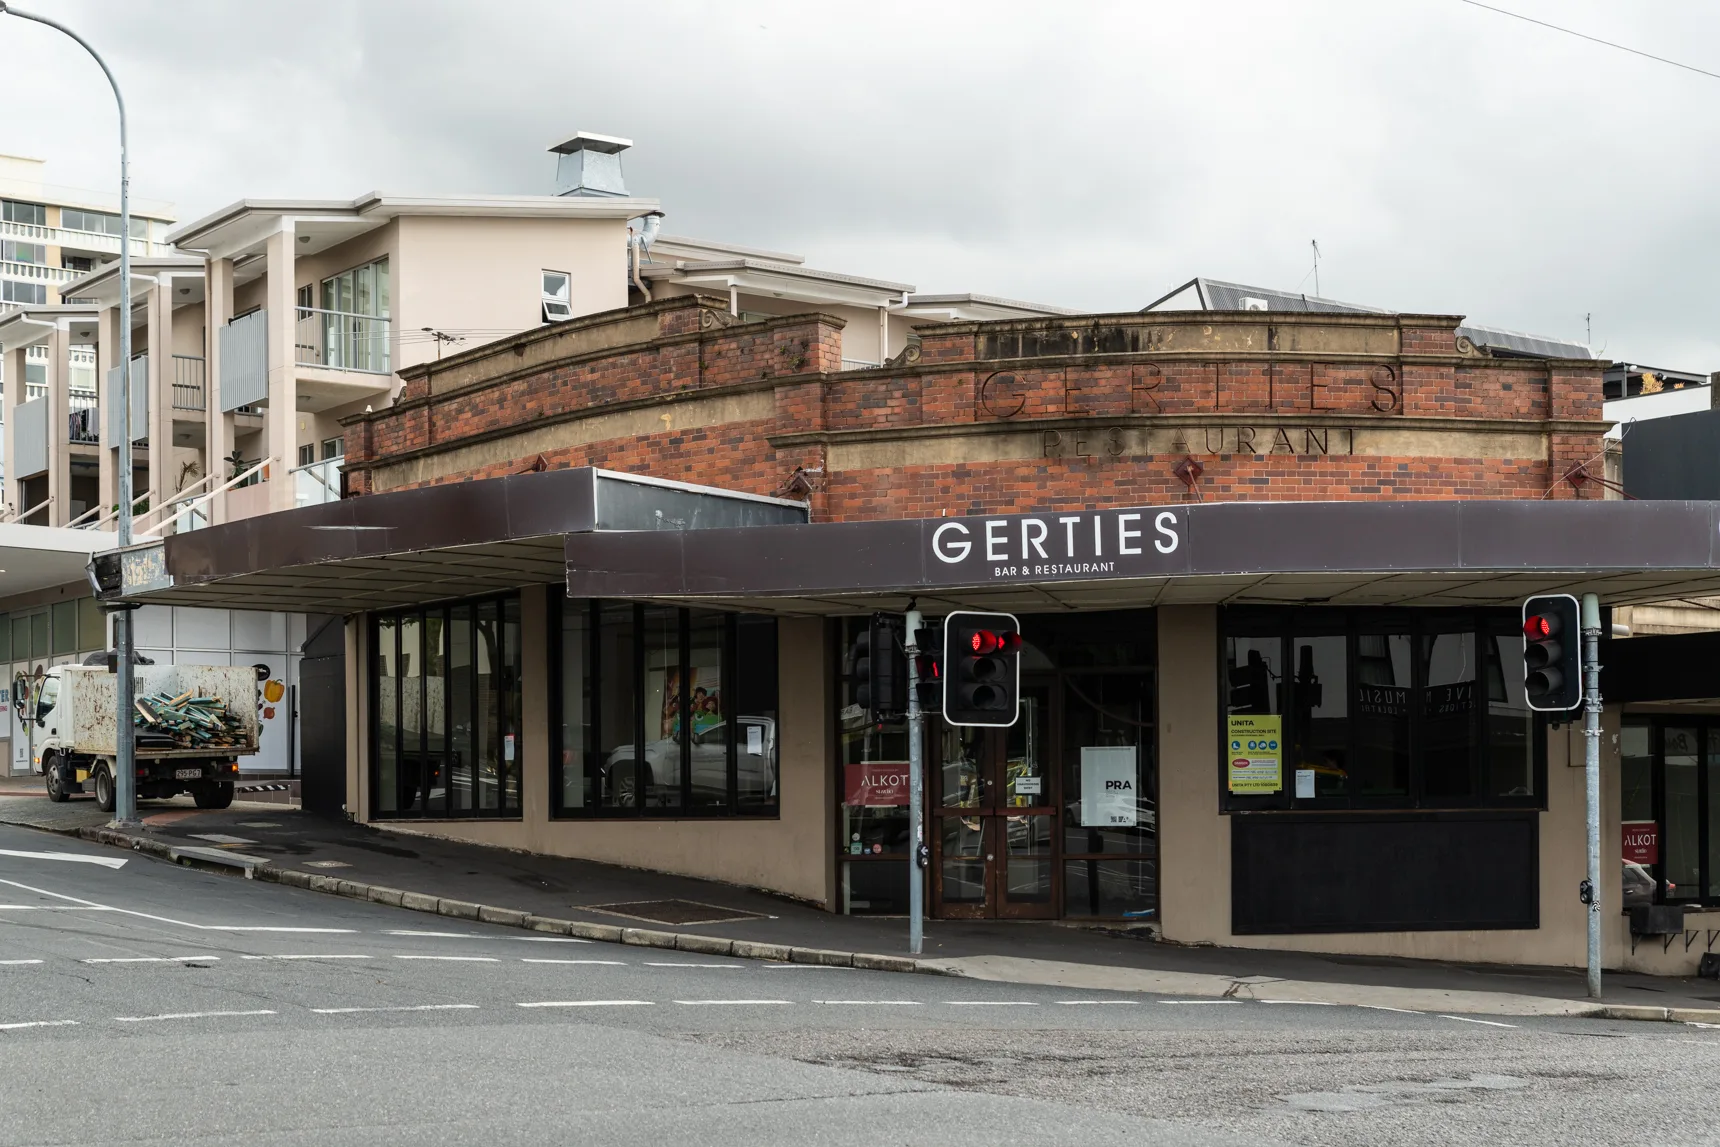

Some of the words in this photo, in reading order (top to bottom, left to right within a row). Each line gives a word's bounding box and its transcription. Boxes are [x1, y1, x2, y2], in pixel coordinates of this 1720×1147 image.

[981, 362, 1398, 418] GERTIES
[1043, 426, 1355, 457] RESTAURANT
[931, 511, 1180, 564] GERTIES
[994, 566, 1017, 577] BAR
[1022, 566, 1031, 576] &
[1035, 562, 1115, 575] RESTAURANT
[861, 774, 909, 787] ALKOT
[1105, 780, 1132, 790] PRA
[1624, 834, 1657, 846] ALKOT
